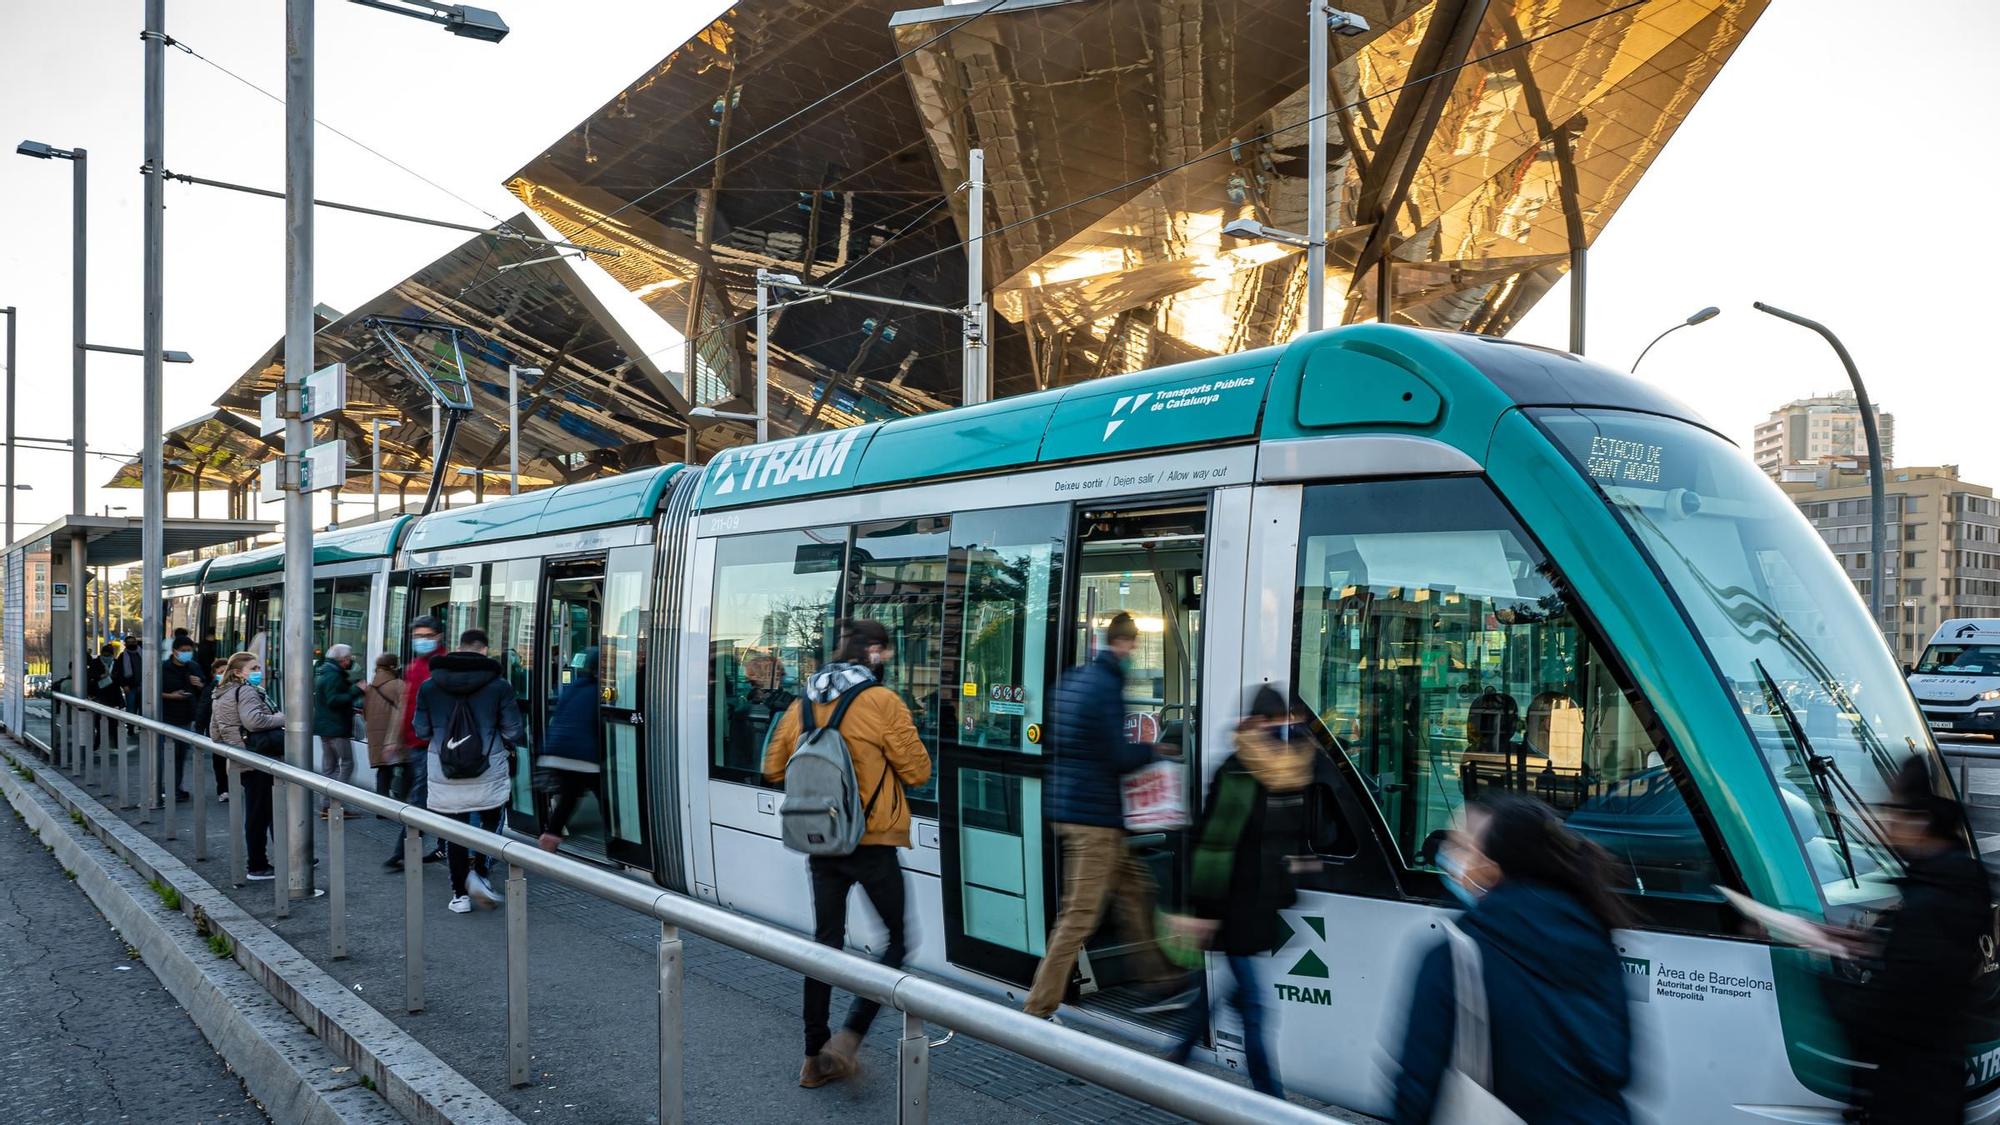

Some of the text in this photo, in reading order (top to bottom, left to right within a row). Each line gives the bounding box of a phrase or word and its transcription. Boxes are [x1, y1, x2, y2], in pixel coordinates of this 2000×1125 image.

[1156, 376, 1255, 401] Transports Públics
[1151, 392, 1220, 412] de Catalunya
[742, 429, 862, 491] TRAM
[1591, 436, 1663, 464] ESTACIO DE
[1054, 481, 1080, 492] Deixeu
[1082, 479, 1104, 489] sortir
[1113, 475, 1136, 487] Dejen
[1137, 473, 1155, 485] salir
[1167, 469, 1189, 482] Allow
[1192, 470, 1209, 480] way
[1212, 466, 1228, 477] out
[1587, 456, 1661, 483] SANT ADRIA
[711, 516, 740, 533] 211-09
[1656, 979, 1752, 999] Autoritat del Transport
[1657, 963, 1773, 992] Àrea de Barcelona
[1274, 983, 1332, 1006] TRAM
[1656, 987, 1705, 1002] Metropolità
